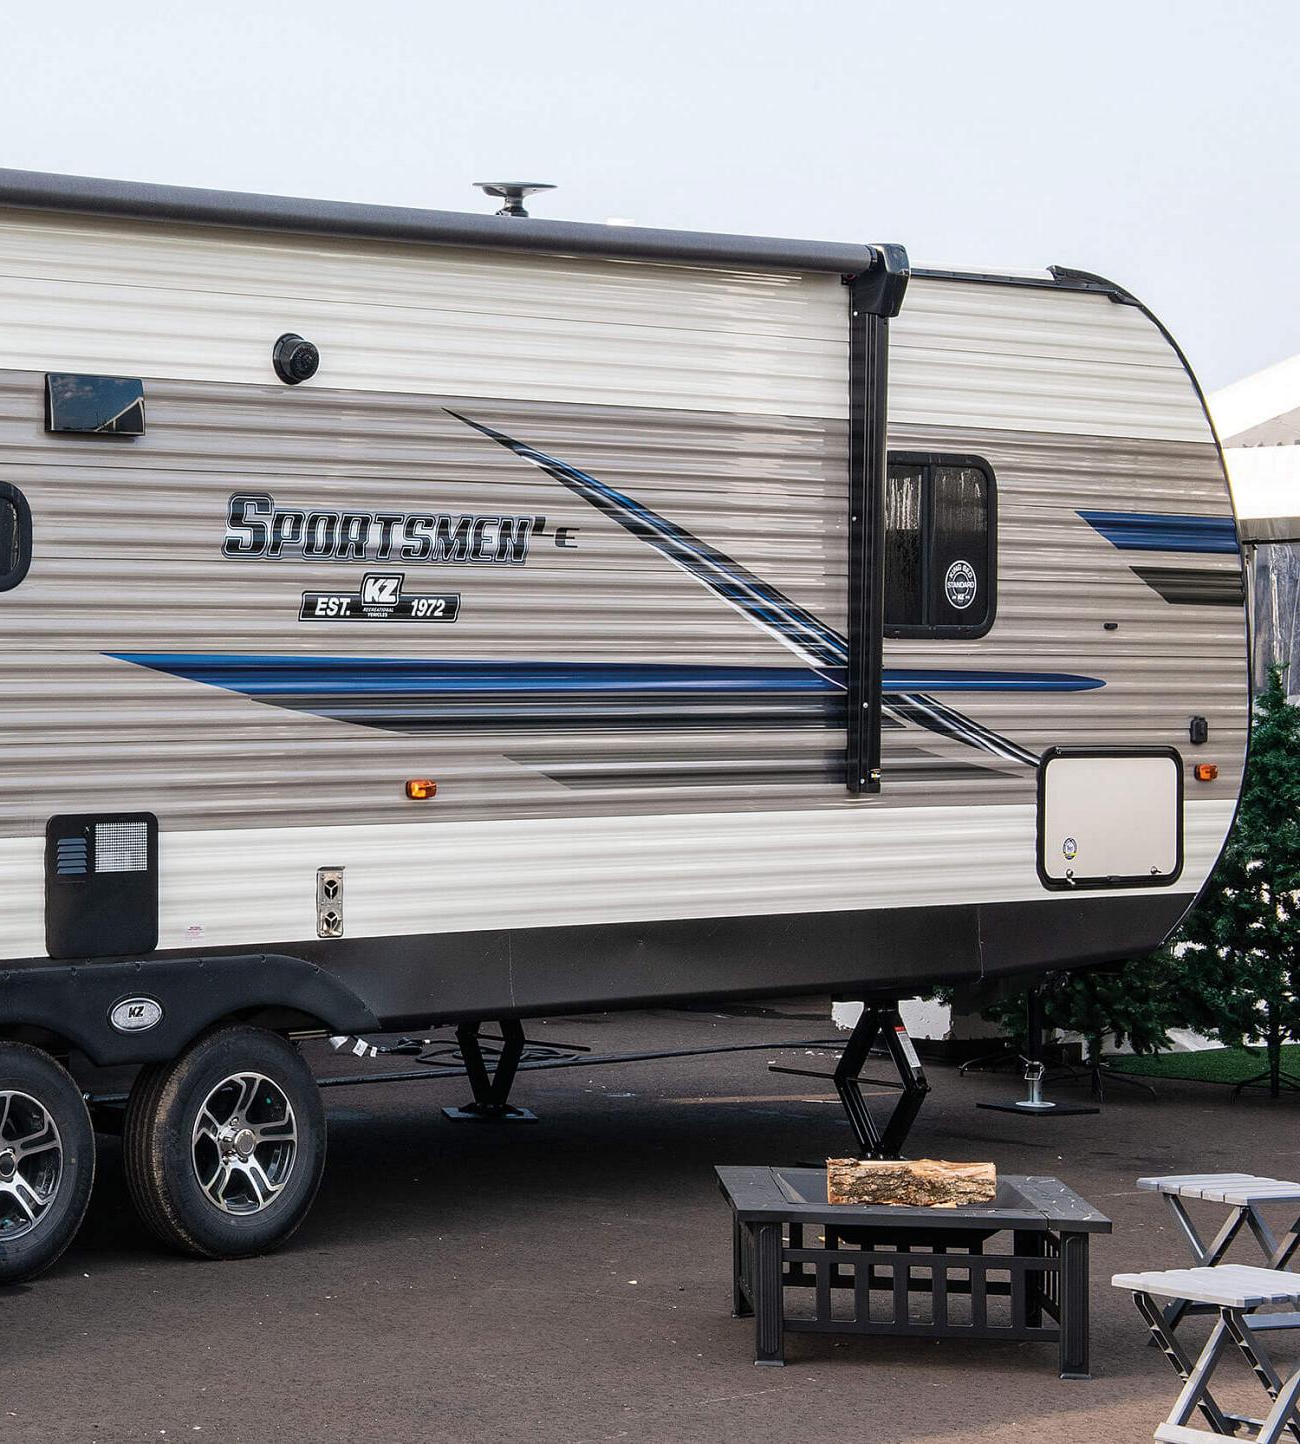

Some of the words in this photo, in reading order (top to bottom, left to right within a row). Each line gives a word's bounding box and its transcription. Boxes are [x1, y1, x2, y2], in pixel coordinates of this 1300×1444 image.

[364, 578, 399, 603] KZ
[947, 581, 975, 589] STANDARD
[314, 597, 351, 616] EST.
[410, 600, 445, 617] 1972
[128, 1005, 145, 1018] KZ
